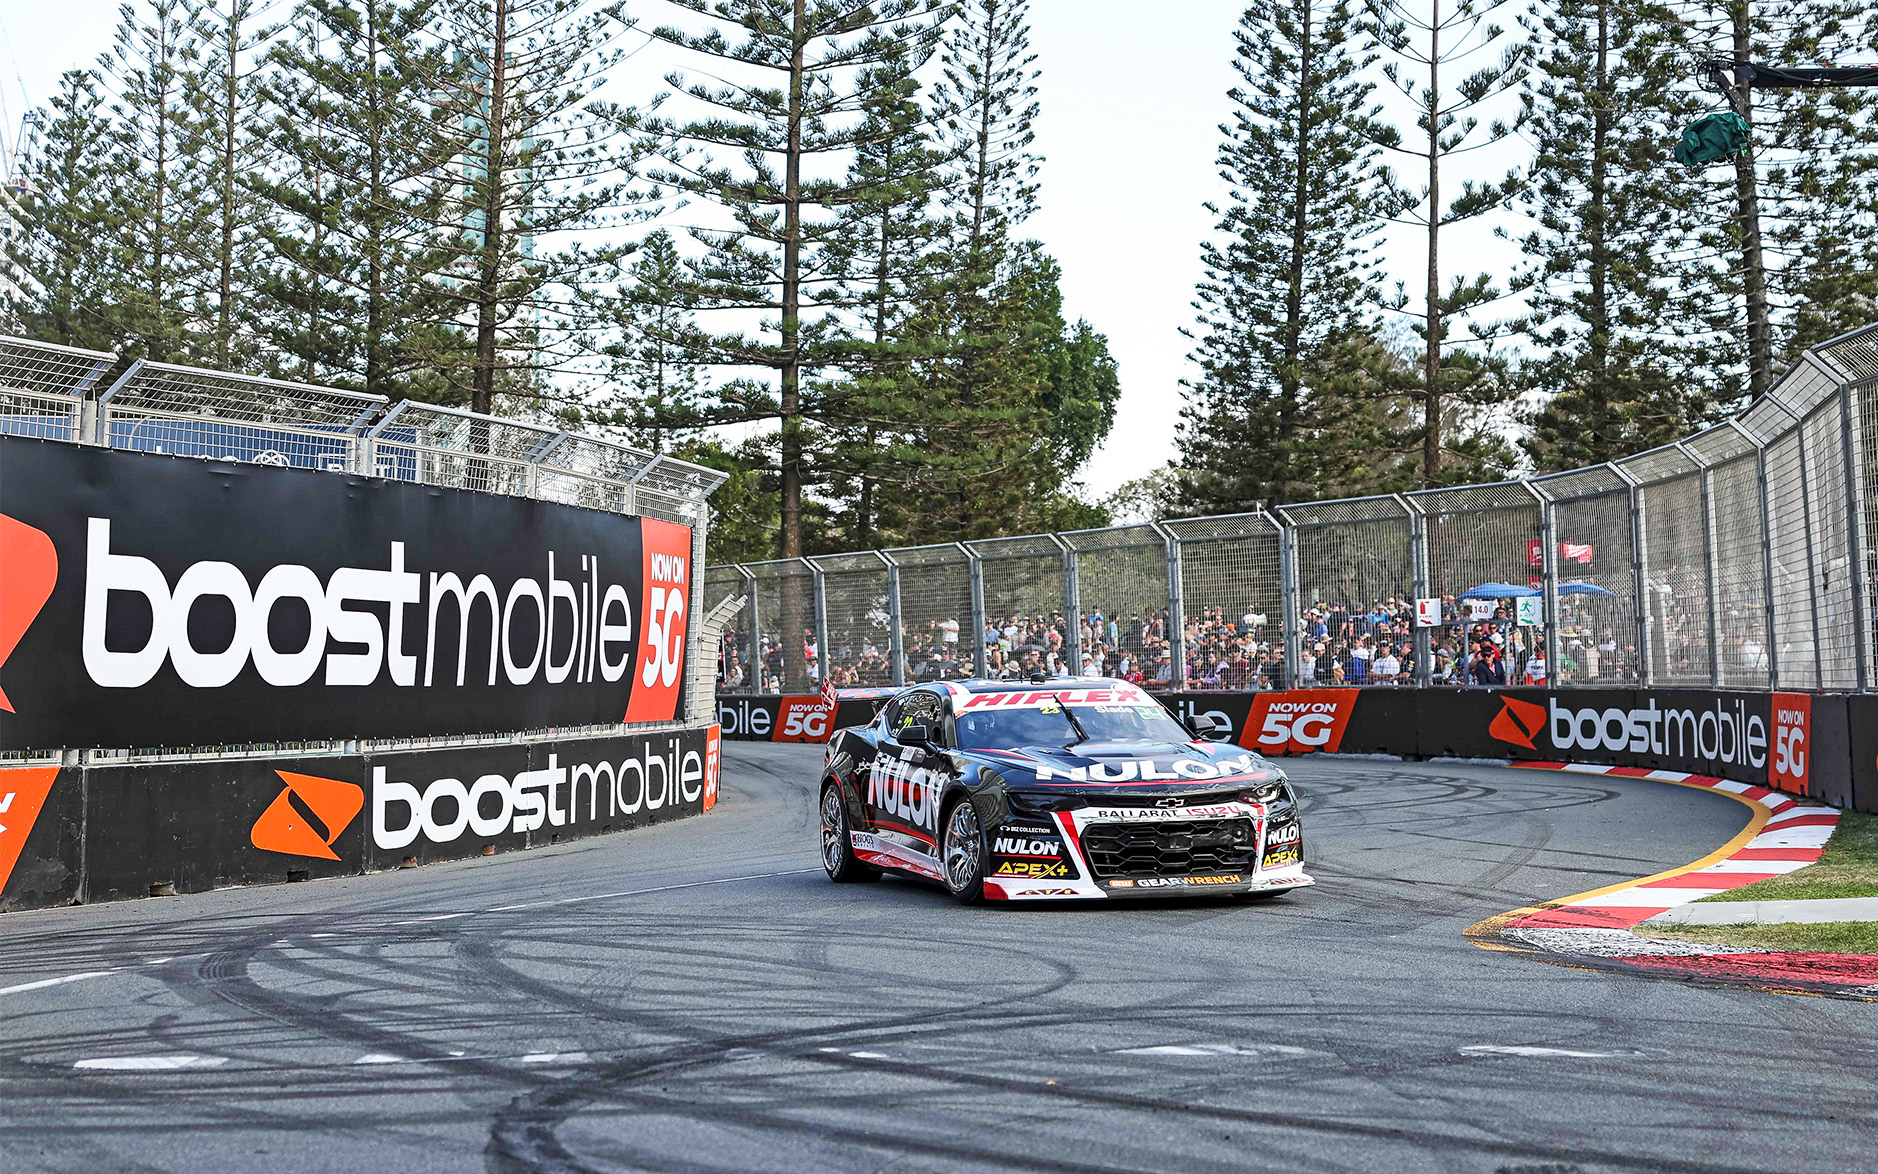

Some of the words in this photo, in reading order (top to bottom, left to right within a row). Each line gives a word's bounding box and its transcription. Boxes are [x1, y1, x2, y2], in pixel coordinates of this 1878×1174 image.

[651, 552, 672, 582] NOW
[673, 558, 685, 584] ON
[82, 517, 632, 688] boostmobile
[1474, 605, 1489, 614] 14.0
[642, 586, 684, 688] 5G
[789, 704, 814, 712] NOW
[964, 690, 1140, 708] HIFLEX
[1268, 703, 1312, 713] NOW
[1311, 703, 1338, 713] ON
[1040, 707, 1061, 715] 23
[1094, 706, 1135, 714] Slade
[1777, 709, 1794, 724] NOW
[1795, 710, 1804, 726] ON
[783, 712, 829, 737] 5G
[1257, 713, 1336, 746] 5G
[1549, 697, 1767, 769] boostmobile
[1775, 725, 1805, 778] 5G
[705, 752, 718, 798] 5G
[1035, 754, 1256, 782] NULON
[372, 738, 703, 850] boostmobile
[1098, 809, 1178, 818] BALLARAT
[1186, 806, 1241, 816] ISUZU
[1020, 826, 1050, 834] COLLECTION
[993, 837, 1060, 856] NULON
[1137, 874, 1242, 888] GEARWRENCH
